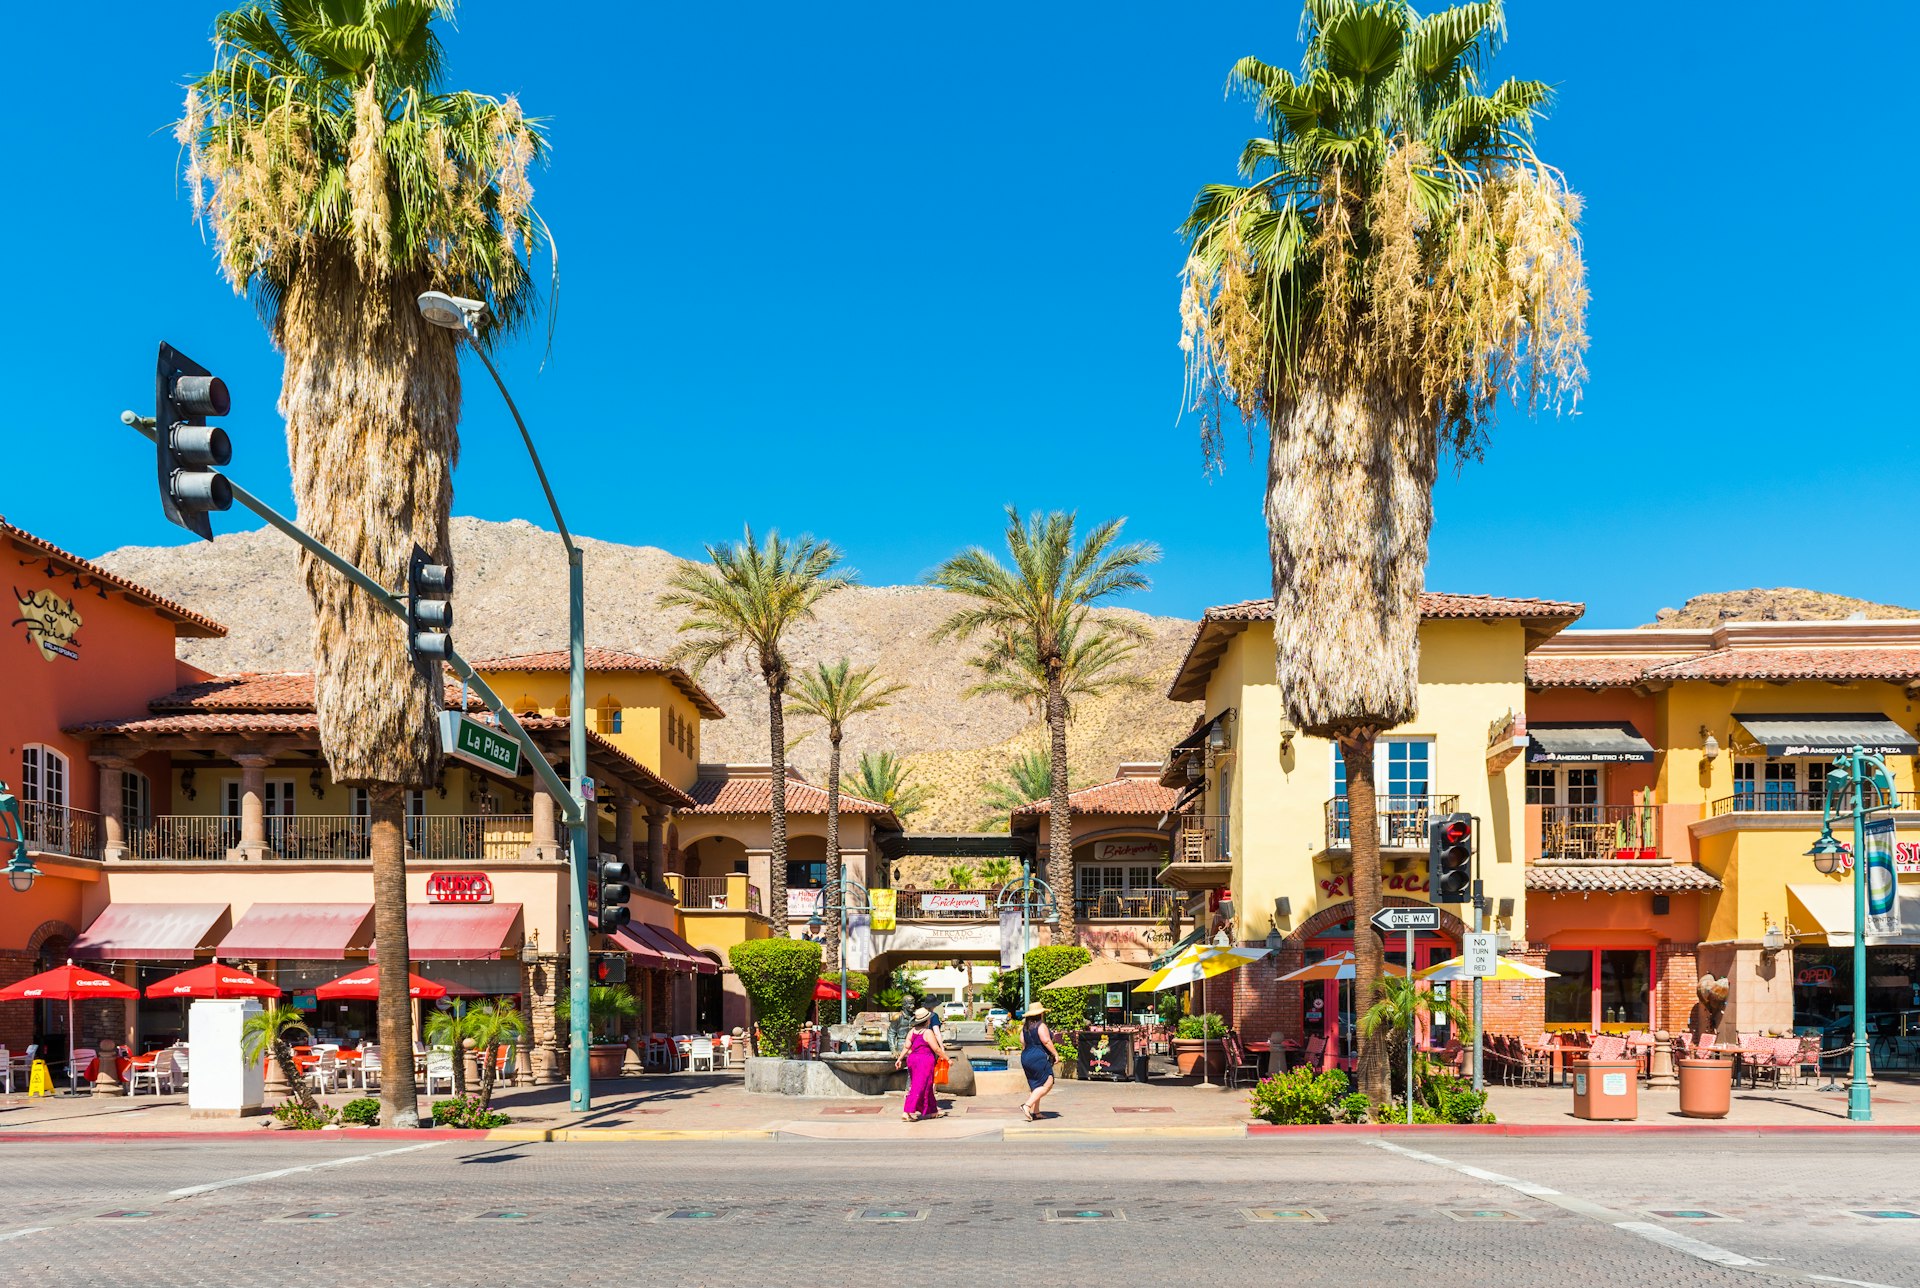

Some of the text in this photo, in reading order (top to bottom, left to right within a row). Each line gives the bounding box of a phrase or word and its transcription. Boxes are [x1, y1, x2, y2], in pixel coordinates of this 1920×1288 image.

[13, 585, 83, 627] Wilma
[12, 619, 82, 647] Frieda
[467, 728, 511, 763] La Plaza
[1098, 842, 1159, 859] Brickworks
[925, 895, 980, 909] Brickworks
[1391, 914, 1431, 923] ONE WAY
[932, 930, 974, 938] MERCADO
[1473, 938, 1487, 947] NO
[1798, 969, 1833, 982] OPEN
